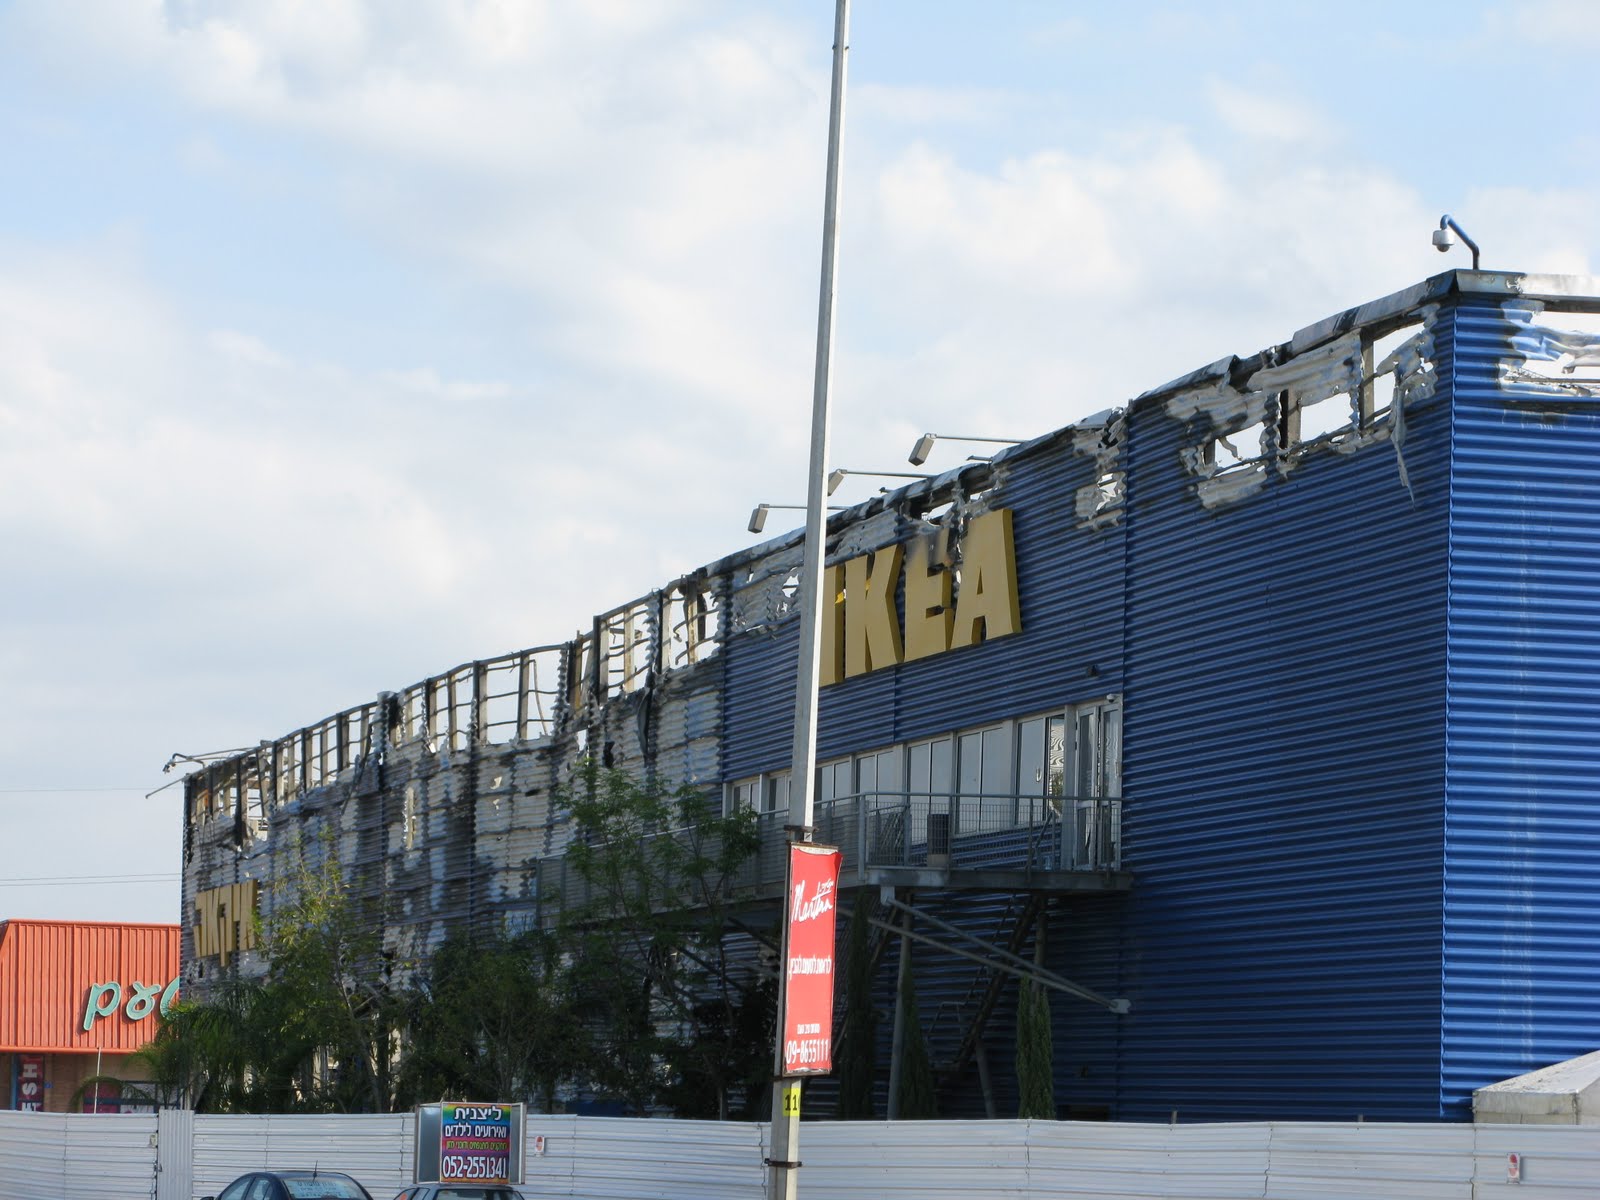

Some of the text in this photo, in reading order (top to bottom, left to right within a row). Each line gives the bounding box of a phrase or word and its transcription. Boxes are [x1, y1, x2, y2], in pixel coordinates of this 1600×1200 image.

[819, 508, 1022, 688] IKEA
[786, 1039, 828, 1064] 09-8655111
[454, 1105, 501, 1120] ליצנית
[445, 1122, 506, 1137] ואירועים לילדים
[443, 1155, 506, 1178] 052-2551341
